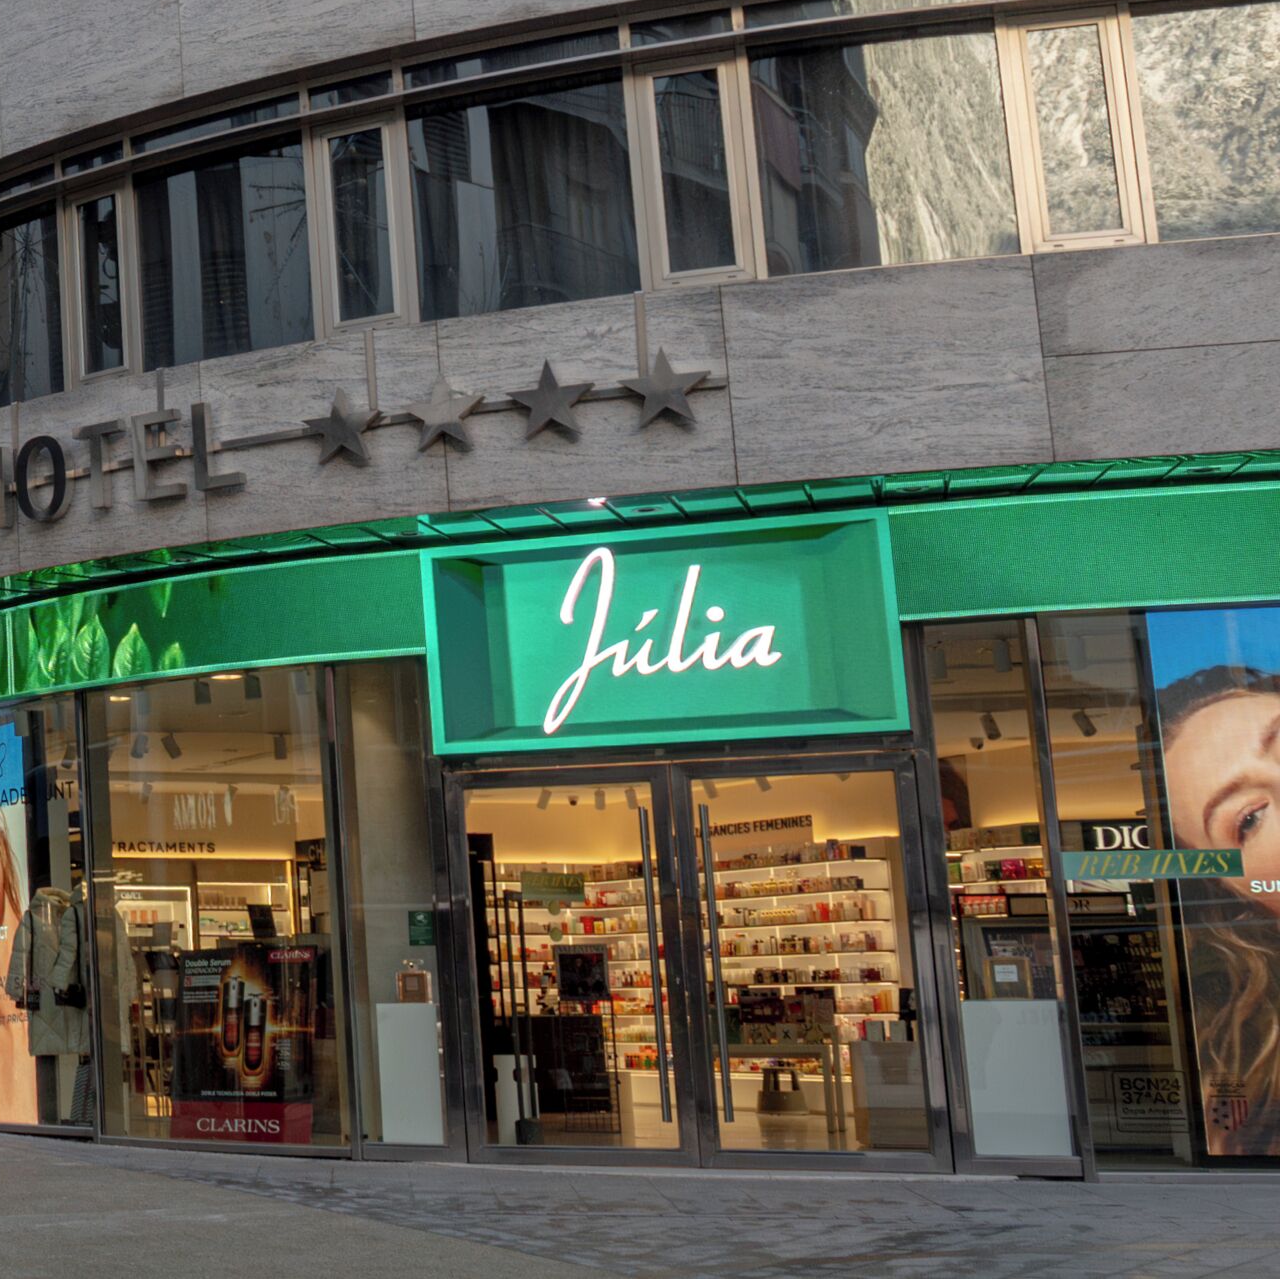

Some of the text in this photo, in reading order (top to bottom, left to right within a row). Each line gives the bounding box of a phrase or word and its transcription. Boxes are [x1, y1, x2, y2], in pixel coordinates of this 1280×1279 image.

[543, 546, 782, 735] Júlia
[753, 814, 812, 832] FEMENINES
[1079, 851, 1232, 876] REBAIXES
[185, 958, 232, 968] Double Serum
[1119, 1077, 1182, 1091] BCN24
[195, 1117, 281, 1134] CLARINS
